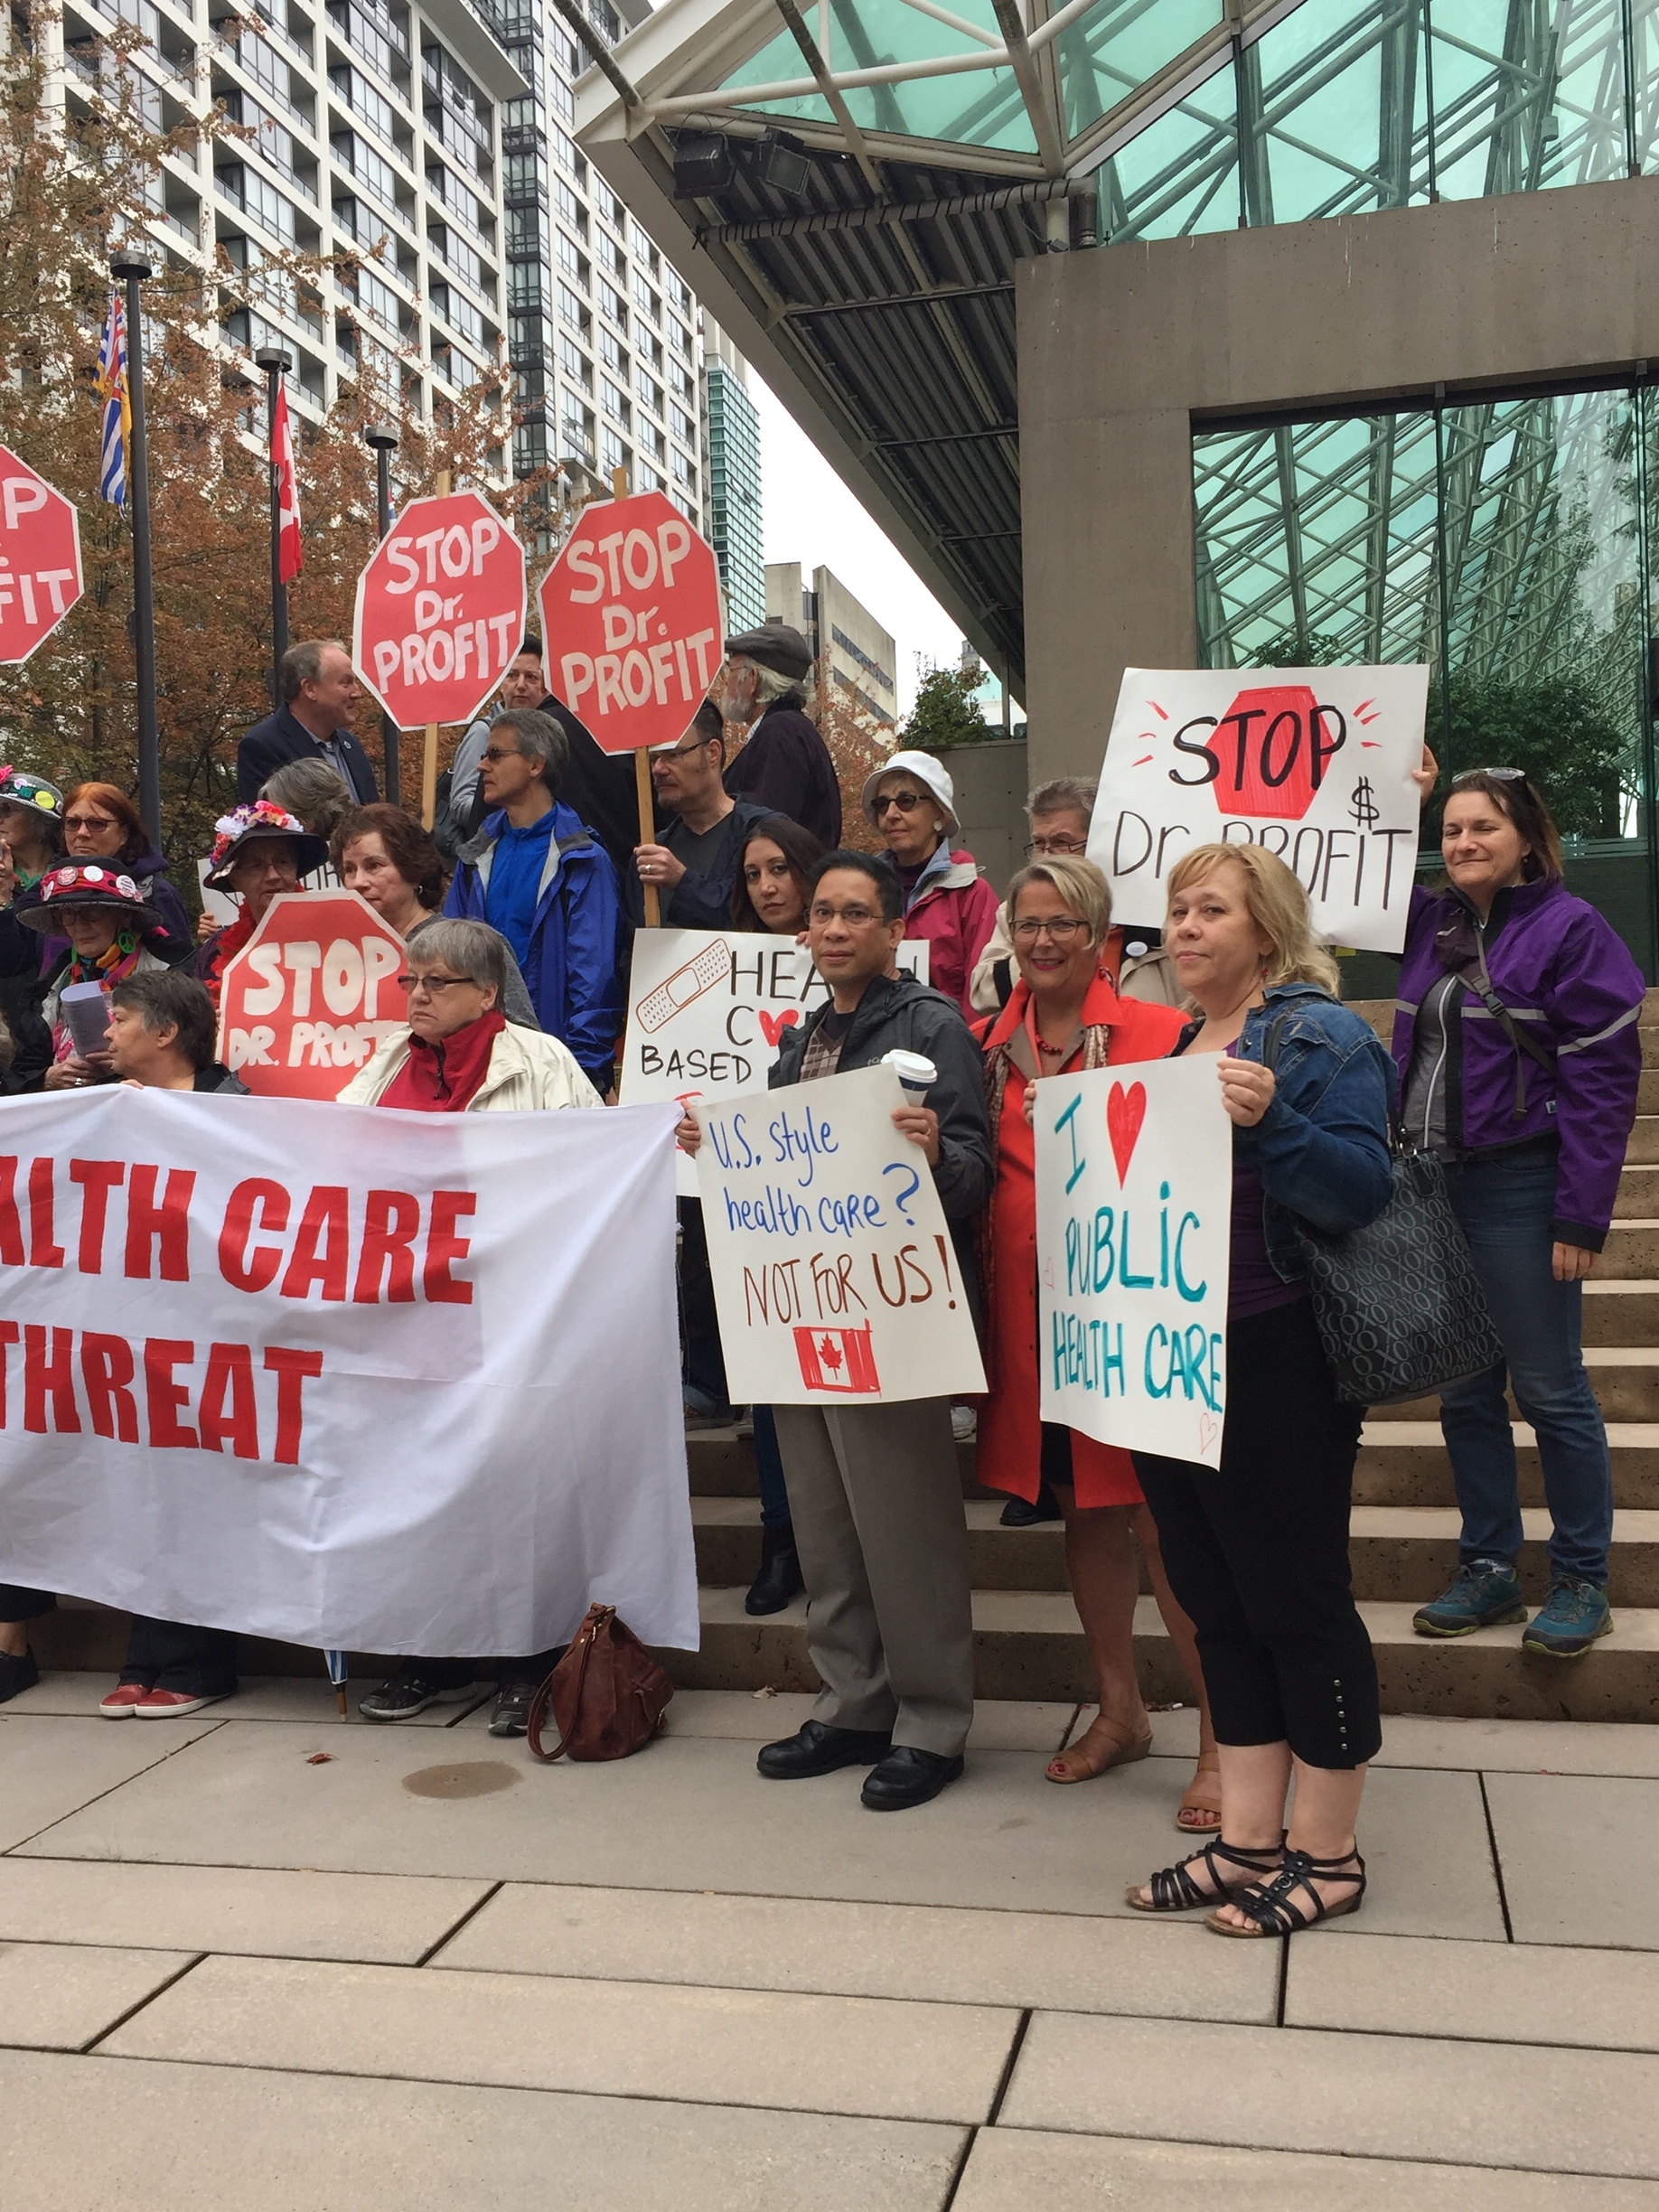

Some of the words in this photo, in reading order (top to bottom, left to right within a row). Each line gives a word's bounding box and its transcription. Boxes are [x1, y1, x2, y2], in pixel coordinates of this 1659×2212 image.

[385, 517, 500, 595] STOP
[566, 520, 691, 605] STOP
[373, 611, 516, 694] PROFIT
[415, 590, 464, 633] Dr.
[602, 604, 668, 652] Dr.
[560, 628, 715, 716] PROFIT
[1168, 705, 1347, 792] STOP
[1112, 811, 1191, 879] Dr
[243, 936, 402, 1019] STOP
[229, 1025, 280, 1073] DR.
[642, 1044, 753, 1084] BASED
[709, 1113, 763, 1170] U.S.
[769, 1106, 839, 1187] style
[1054, 1092, 1086, 1195] I
[218, 1177, 477, 1305] CARE
[724, 1185, 812, 1237] health
[744, 1259, 801, 1326] NOT
[810, 1251, 868, 1320] FOR
[871, 1234, 957, 1310] US!
[1053, 1310, 1126, 1399] HEALTH
[1144, 1322, 1223, 1414] CARE
